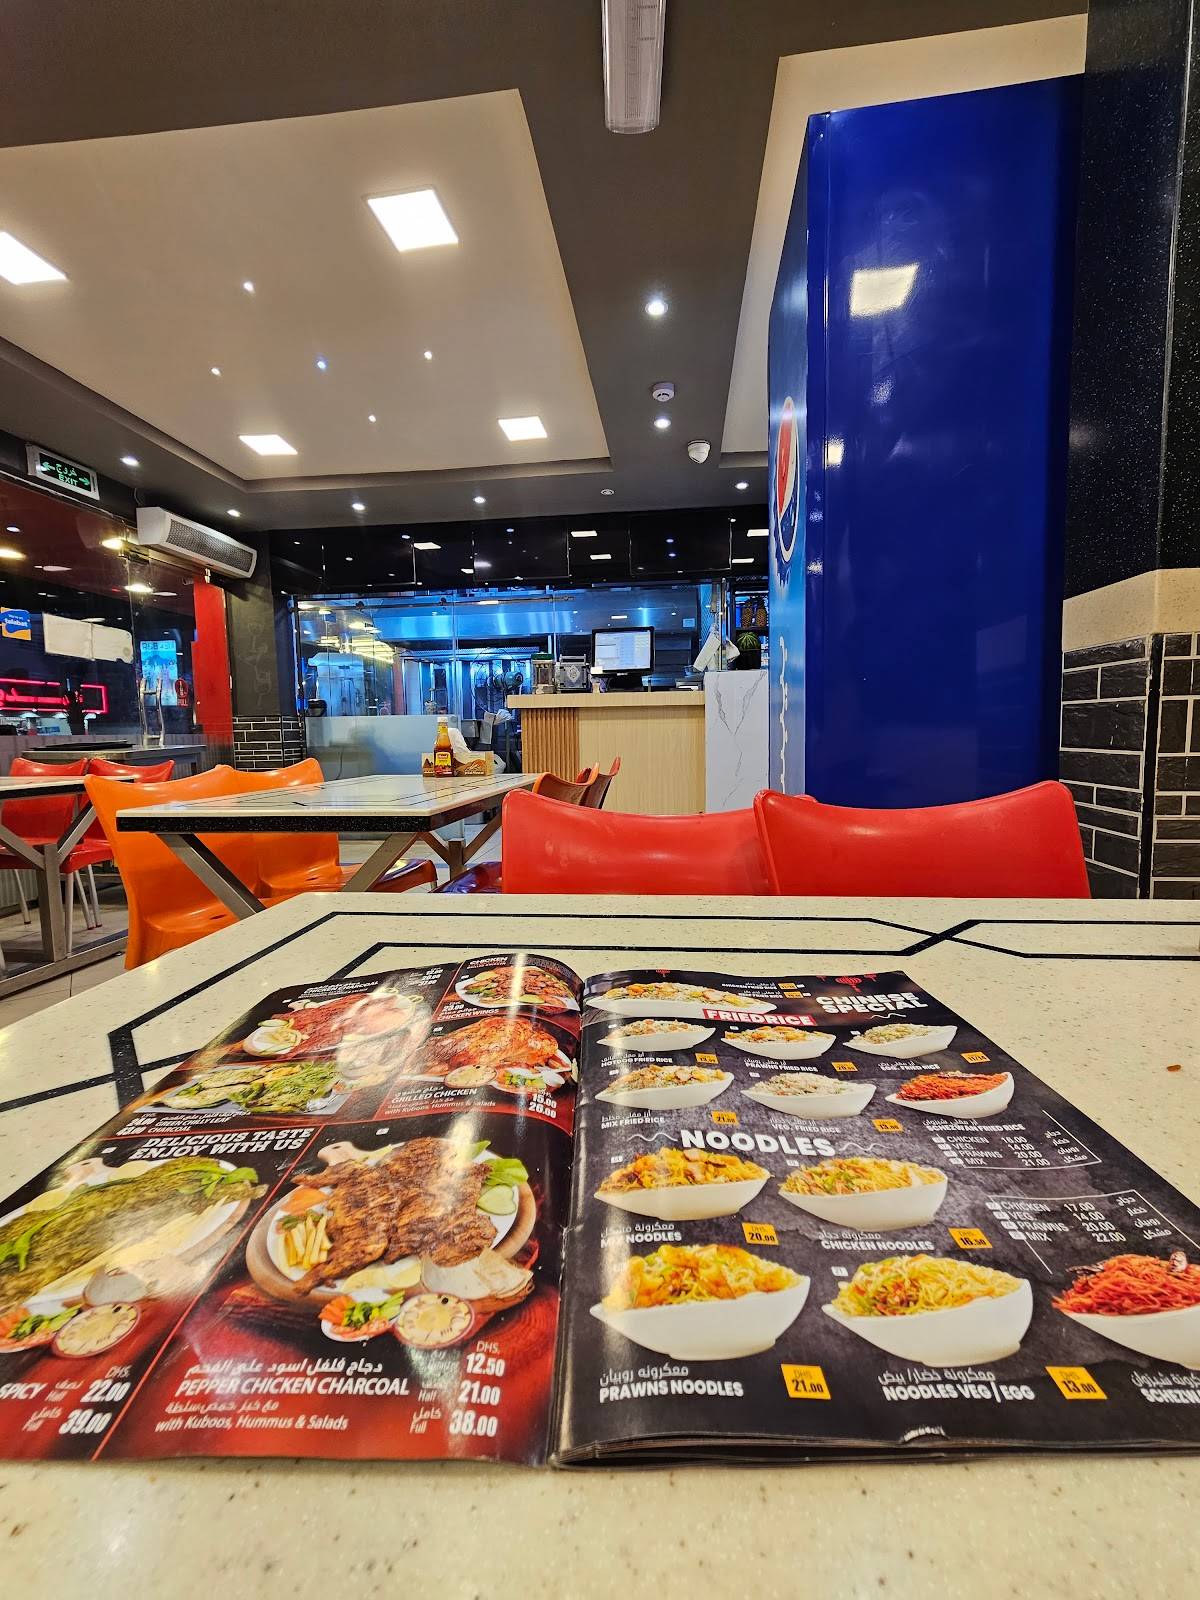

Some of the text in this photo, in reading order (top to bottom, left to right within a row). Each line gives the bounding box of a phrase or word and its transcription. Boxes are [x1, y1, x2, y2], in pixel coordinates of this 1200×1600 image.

[58, 473, 78, 486] EXIT
[815, 992, 920, 1005] CHINESE
[437, 1013, 472, 1021] CHICKEN
[472, 1008, 500, 1016] WINGS
[822, 1000, 928, 1014] SPECIAL
[391, 1093, 433, 1104] GRILLED
[433, 1088, 478, 1098] CHICKEN
[531, 1093, 557, 1109] 15.00
[147, 1126, 192, 1134] CHARCOAL
[601, 1121, 619, 1130] MIX
[619, 1118, 644, 1127] FRIED
[645, 1116, 665, 1124] RICE
[795, 1124, 820, 1132] FRIED
[926, 1123, 1026, 1132] SCHEZWAN FRIED RICE
[142, 1128, 315, 1149] DELICIOUS TASTE
[680, 1129, 836, 1157] NOODLES
[947, 1136, 990, 1144] CHICKEN
[128, 1137, 305, 1161] ENJOY WITH US
[958, 1150, 1042, 1159] PRAWNS 20.00
[965, 1157, 988, 1166] MIX
[1001, 1201, 1095, 1212] CHICKEN 17.00
[1007, 1211, 1105, 1221] VEG. 14.00
[1017, 1220, 1116, 1232] PRAWNS 20.00
[626, 1231, 682, 1244] NOODLES
[1025, 1231, 1127, 1243] MIX 22.00
[820, 1240, 935, 1251] CHICKEN NOODLES
[475, 1340, 500, 1354] DHS.
[105, 1364, 132, 1379] DHS.
[267, 1358, 305, 1375] اسود
[306, 1358, 346, 1375] فلفل
[346, 1358, 383, 1375] دجاج
[465, 1352, 505, 1377] 12.50
[600, 1367, 634, 1387] روبيان
[0, 1382, 48, 1399] SPICY
[80, 1378, 131, 1403] 22.00
[175, 1377, 239, 1397] PEPPER
[240, 1377, 316, 1395] CHICKEN
[316, 1377, 410, 1396] CHARCOAL
[418, 1389, 438, 1402] Half
[457, 1380, 501, 1406] 21.00
[600, 1379, 744, 1403] PRAWNS NOODLES
[791, 1378, 824, 1393] 21.00
[882, 1383, 959, 1401] NOODLES
[1061, 1379, 1097, 1395] 13.00
[58, 1408, 113, 1435] 39.00
[154, 1414, 349, 1433] with Kuboos, Hummus & Salads
[409, 1409, 499, 1437] Full 38.00
